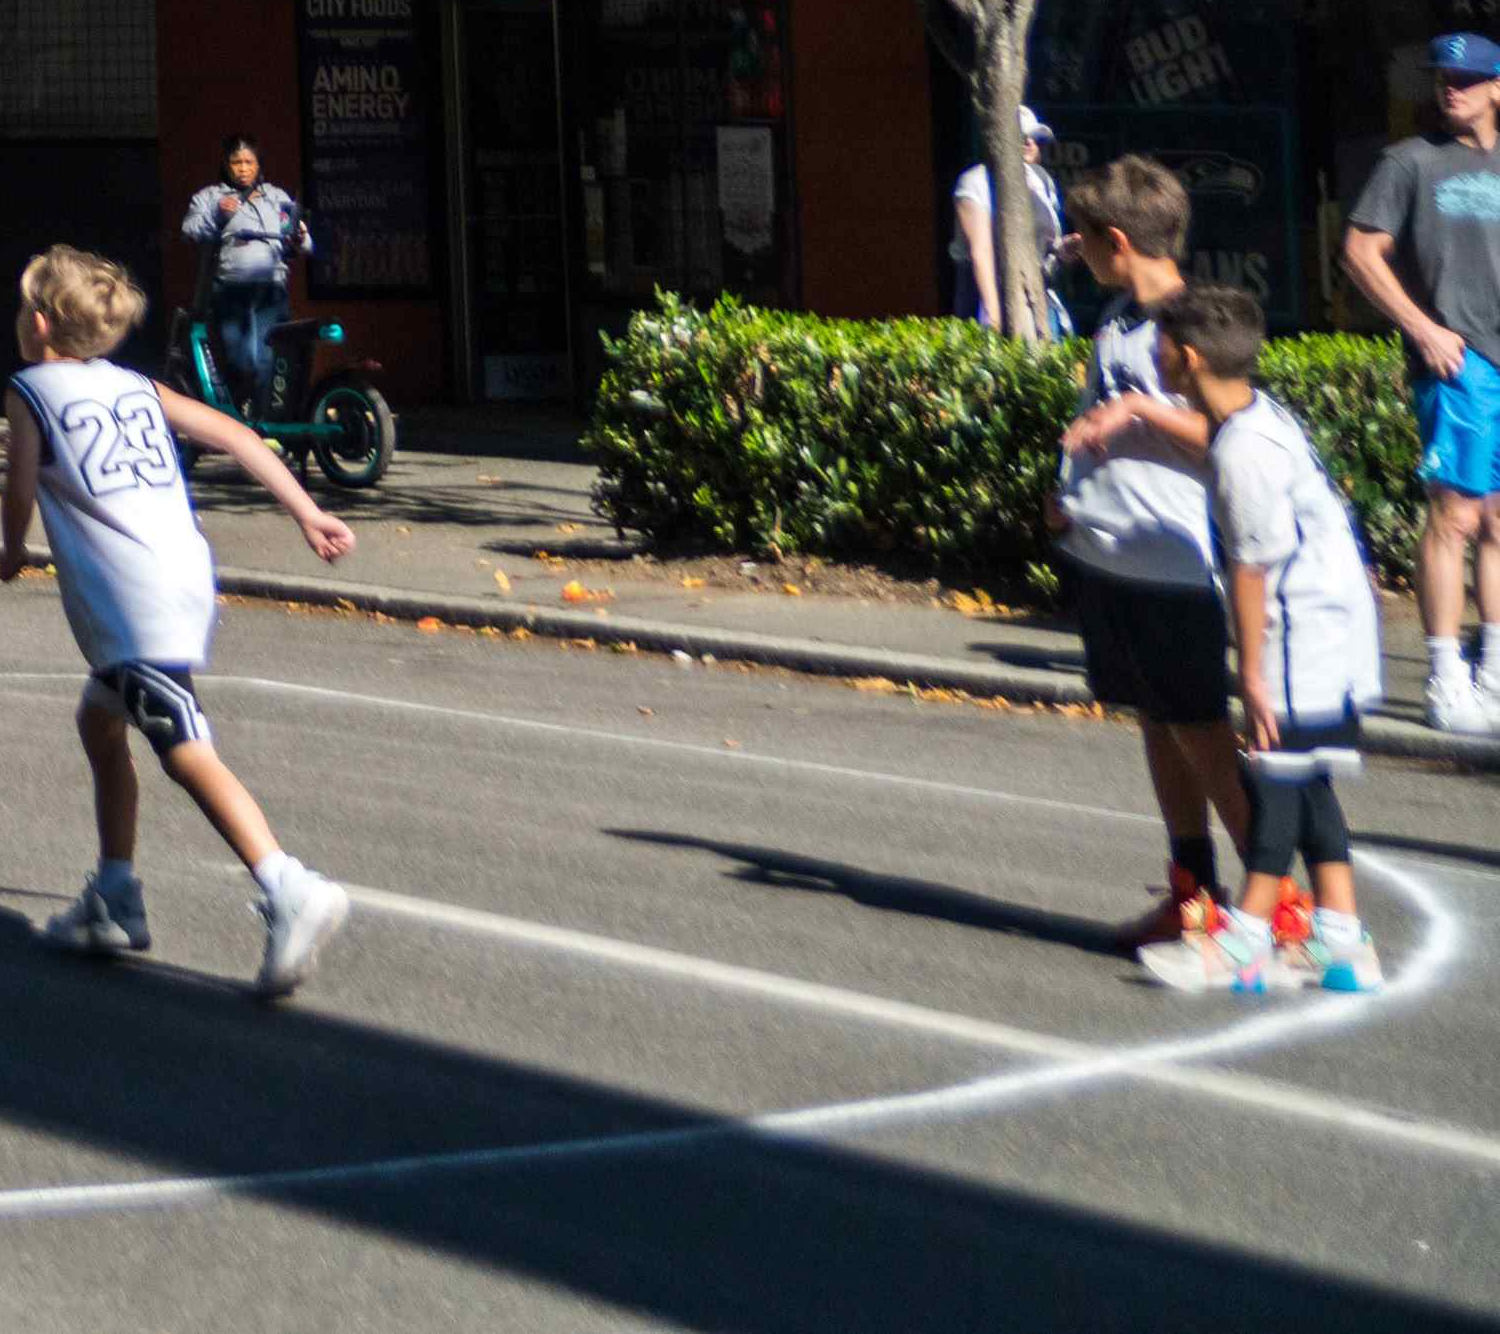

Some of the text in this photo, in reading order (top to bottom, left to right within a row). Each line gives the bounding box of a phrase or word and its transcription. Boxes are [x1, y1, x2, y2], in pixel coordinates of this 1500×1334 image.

[1126, 13, 1212, 74] BUD
[312, 94, 411, 118] ENERGY
[62, 391, 178, 498] 23
